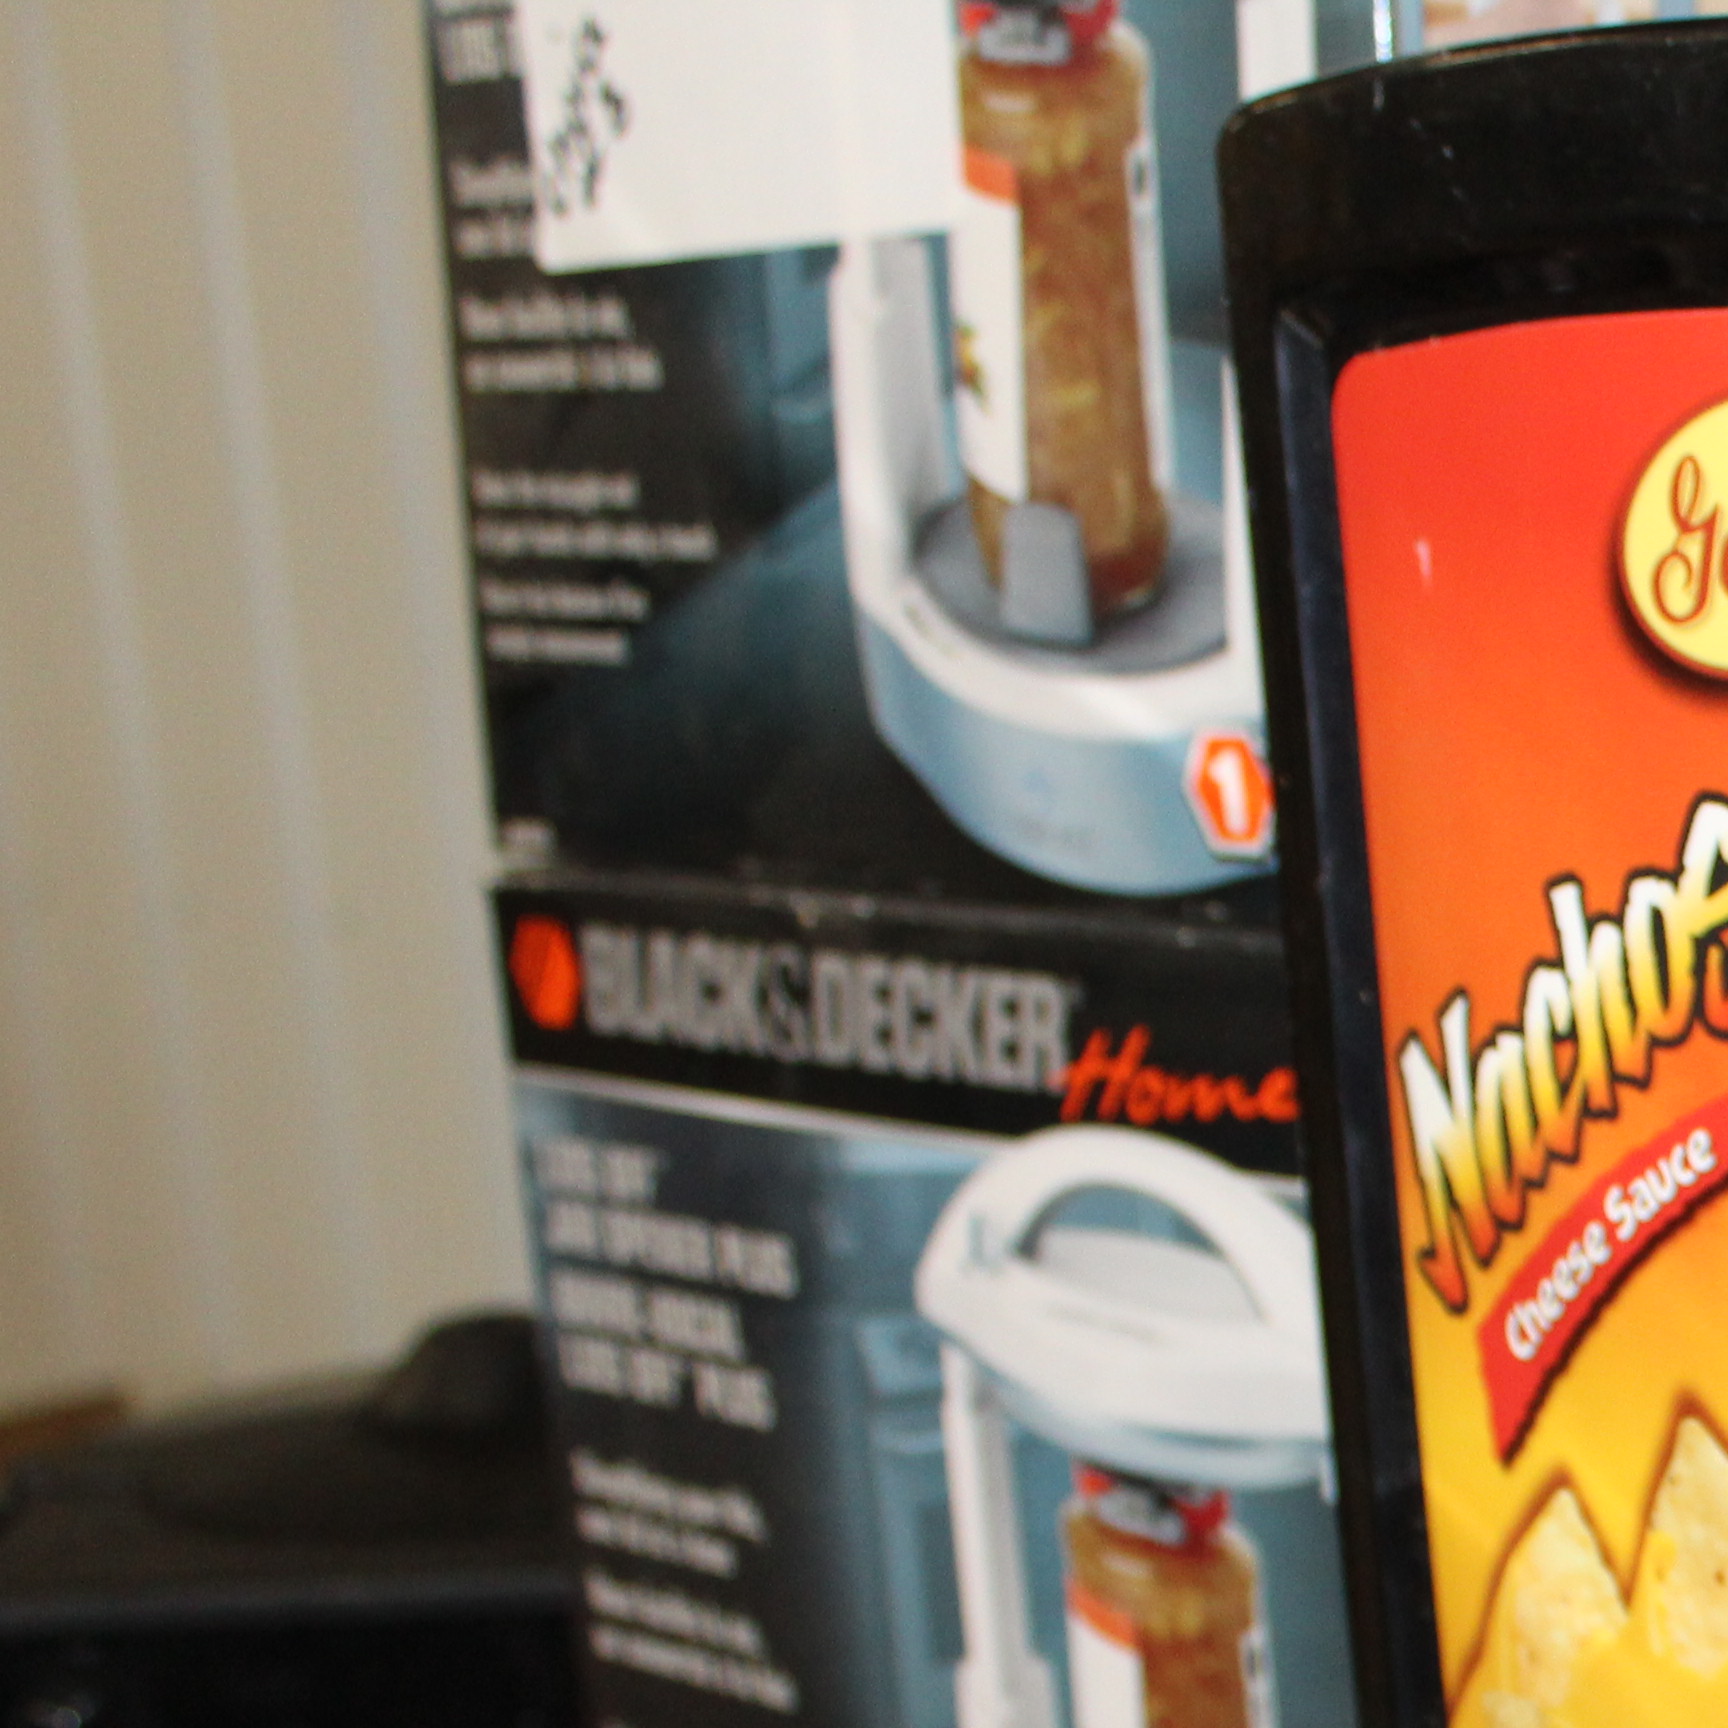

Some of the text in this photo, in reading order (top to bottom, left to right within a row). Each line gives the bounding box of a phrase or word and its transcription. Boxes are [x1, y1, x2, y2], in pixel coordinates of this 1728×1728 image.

[1052, 1023, 1302, 1126] Home
[1500, 1127, 1718, 1363] Cheese Sauce
